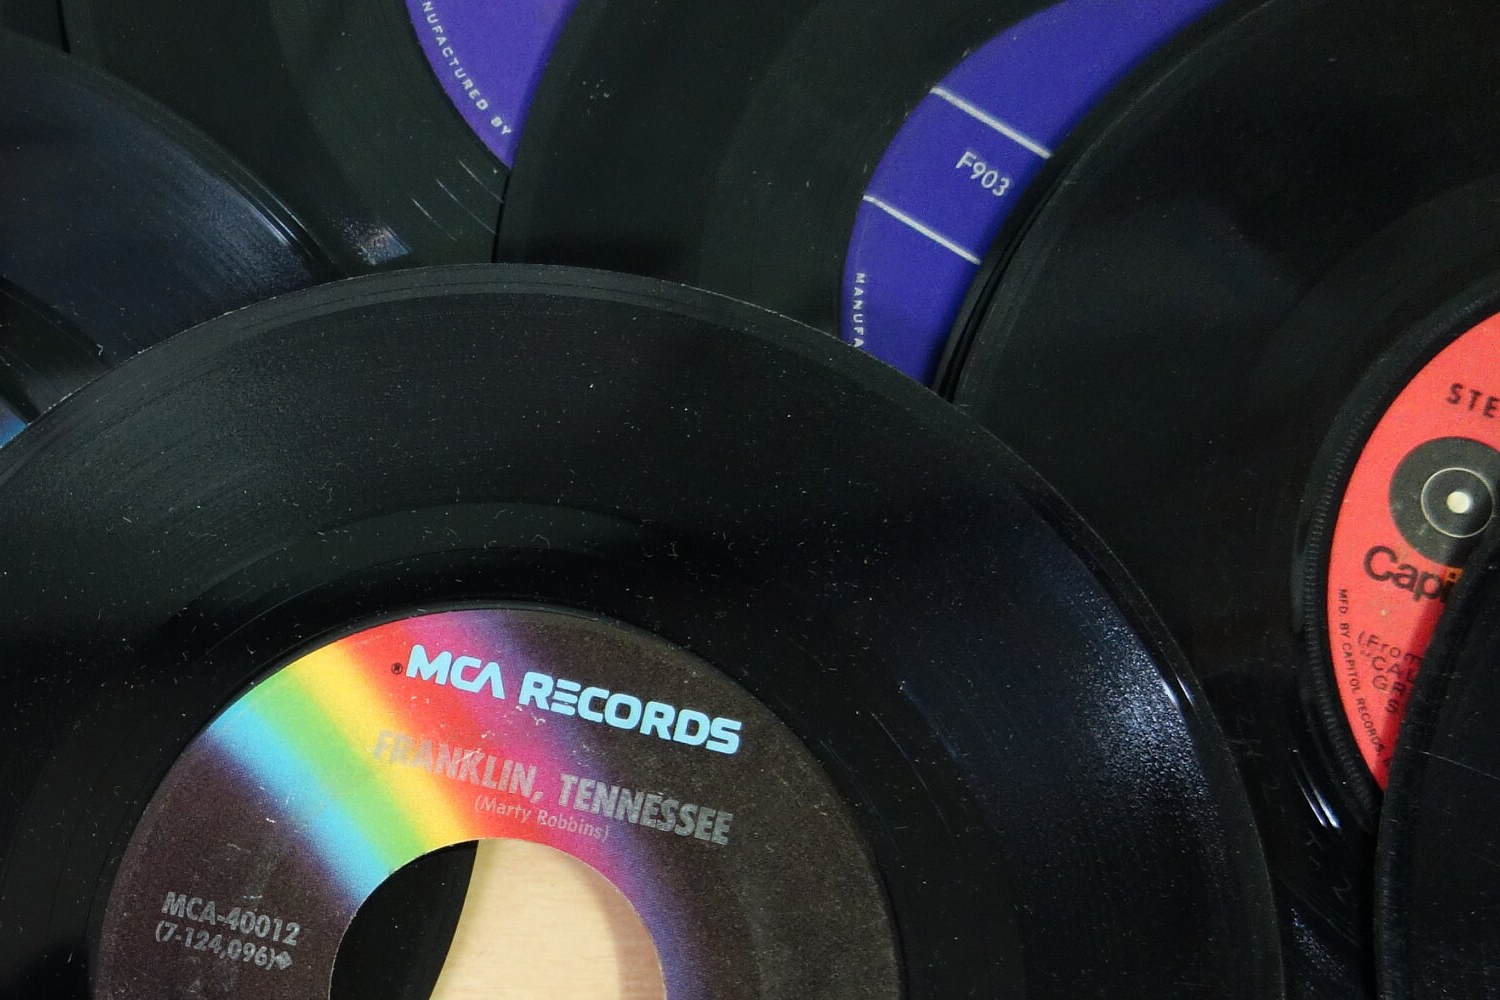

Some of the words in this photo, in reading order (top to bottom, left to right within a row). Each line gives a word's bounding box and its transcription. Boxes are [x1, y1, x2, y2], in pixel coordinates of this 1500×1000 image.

[490, 116, 512, 135] BY
[954, 150, 1011, 197] F903
[1340, 622, 1350, 639] BY
[1342, 643, 1361, 696] CAPITOL
[405, 643, 506, 701] MCA
[518, 670, 742, 756] RECORDS
[374, 729, 544, 803] FRANKLIN,
[558, 772, 735, 846] TENNESSEE
[474, 795, 533, 824] (Marty
[536, 808, 610, 842] Robbins)
[161, 890, 301, 947] MCA-40012
